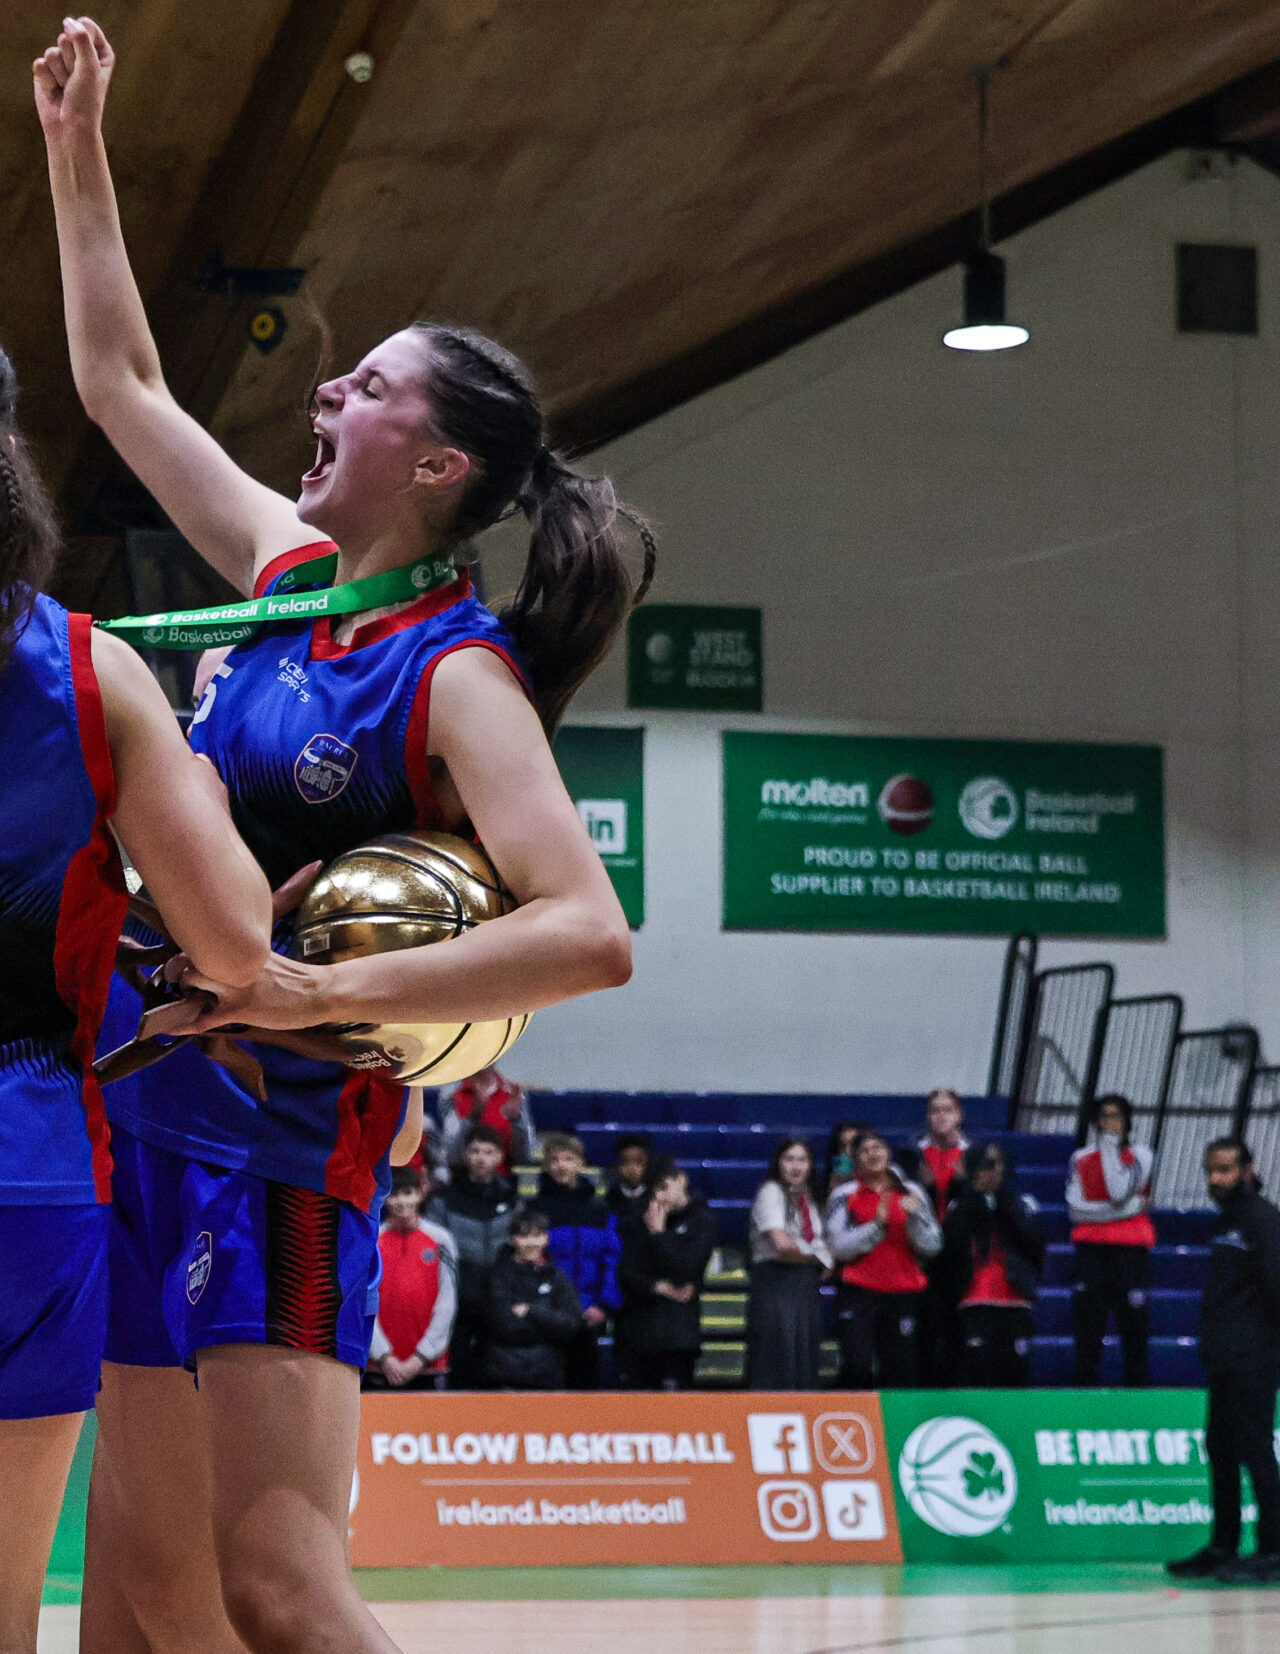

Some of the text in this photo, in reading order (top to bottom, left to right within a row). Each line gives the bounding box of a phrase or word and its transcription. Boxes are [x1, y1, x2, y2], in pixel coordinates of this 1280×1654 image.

[170, 595, 329, 623] Basketball Ireland
[761, 778, 869, 808] molten
[803, 846, 1087, 875] PROUD TO BE OFFICIAL BALL
[770, 874, 1120, 903] SUPPLIER TO BASKETBALL IRELAND
[370, 1432, 735, 1465] FOLLOW BASKETBALL
[1034, 1429, 1076, 1466] BE
[1078, 1429, 1150, 1466] PART
[1154, 1429, 1191, 1466] OF
[436, 1497, 687, 1526] ireland.basketball
[1044, 1498, 1215, 1526] ireland.baske
